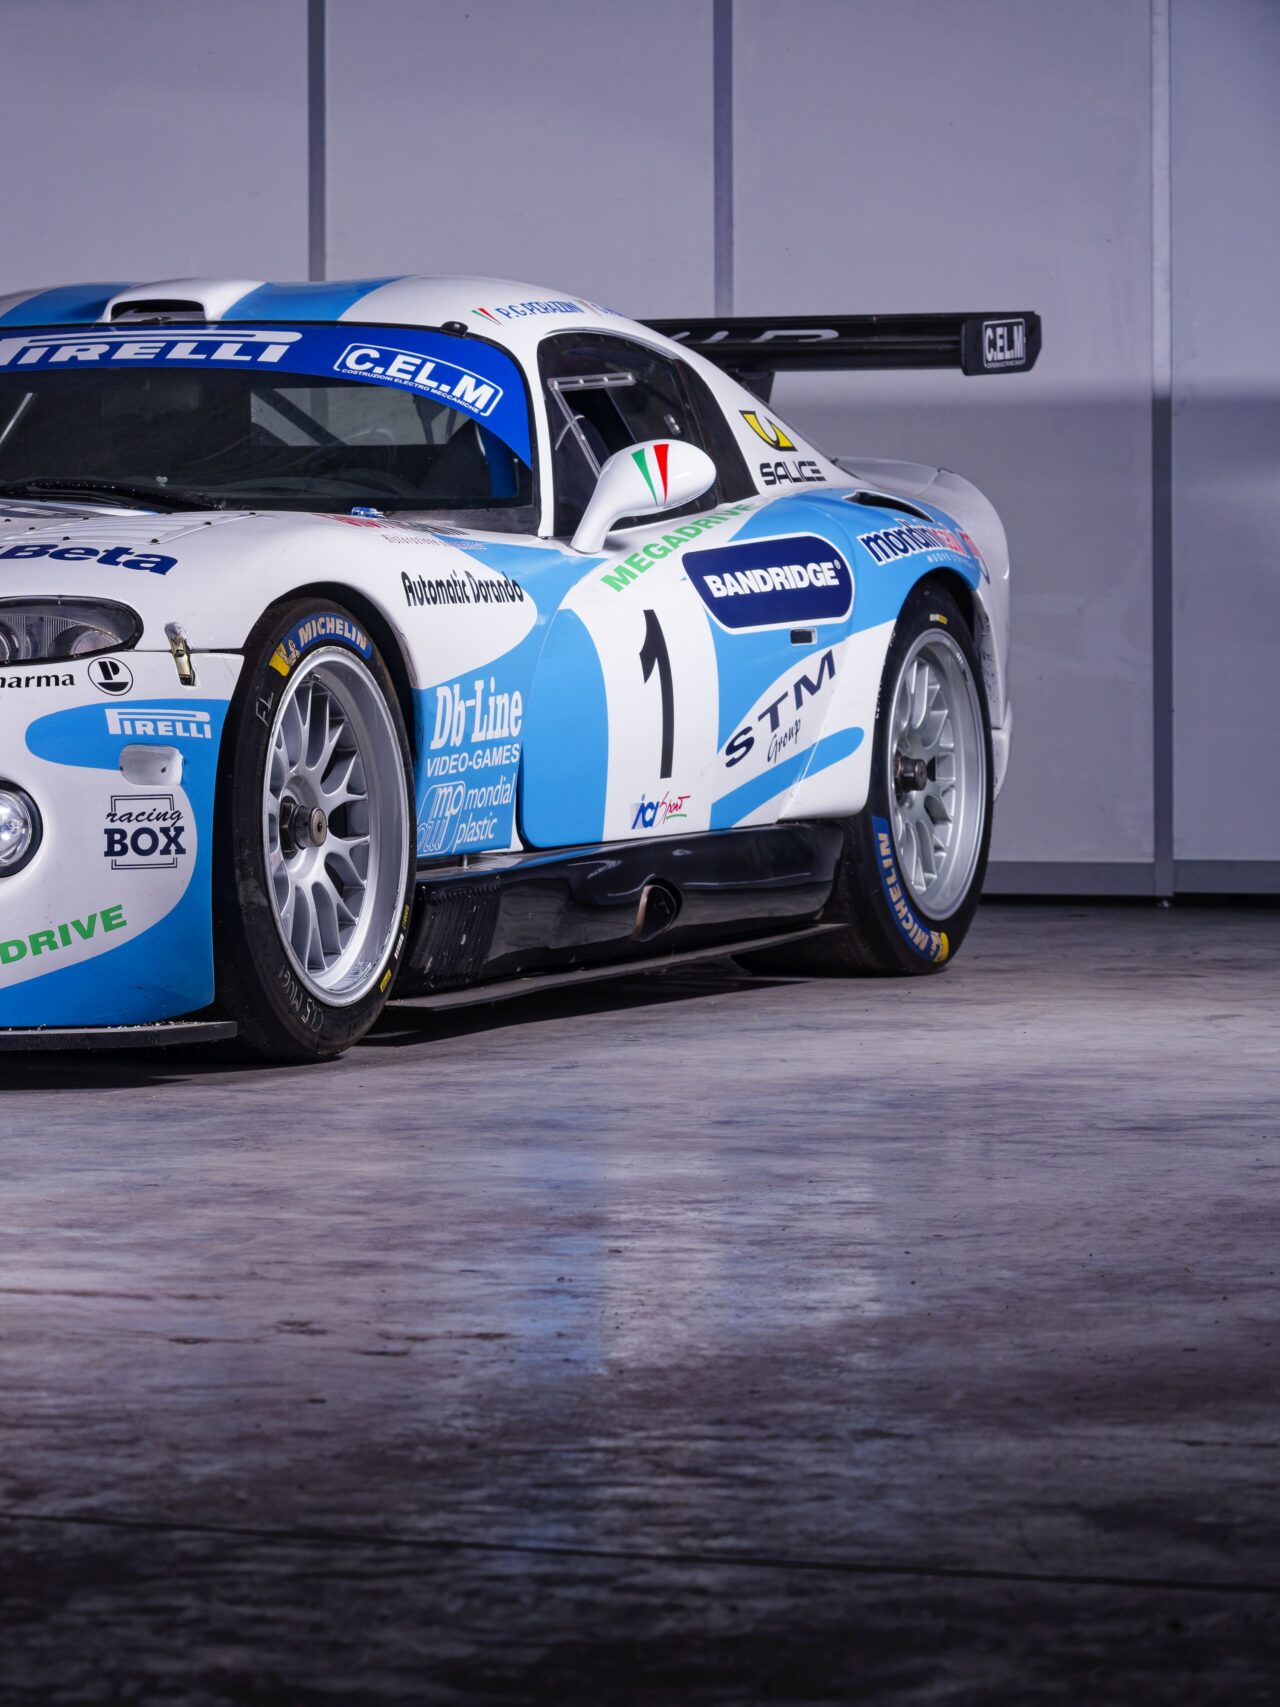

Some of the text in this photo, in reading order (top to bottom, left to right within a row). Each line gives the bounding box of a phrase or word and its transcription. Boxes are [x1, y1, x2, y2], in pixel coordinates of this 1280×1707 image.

[985, 325, 1024, 361] C.EL.M
[341, 368, 481, 414] COSTRUZIONI ELECTRO MECCANICHE
[344, 348, 495, 410] C.EL.M
[759, 460, 827, 486] SALICE
[600, 502, 755, 593] MEGADRIVE
[400, 569, 525, 607] Automatic Dorando
[297, 616, 368, 651] MICHELIN
[429, 675, 523, 751] Db-Line
[639, 608, 675, 779] 1
[724, 649, 836, 768] STM
[104, 708, 212, 739] PIRELLI
[767, 717, 801, 763] Group
[426, 743, 520, 778] VIDEO-GAMES
[463, 772, 517, 811] mondial
[104, 807, 184, 828] racing
[452, 812, 498, 854] plastic
[103, 825, 187, 858] BOX
[877, 832, 930, 951] MICHELIN
